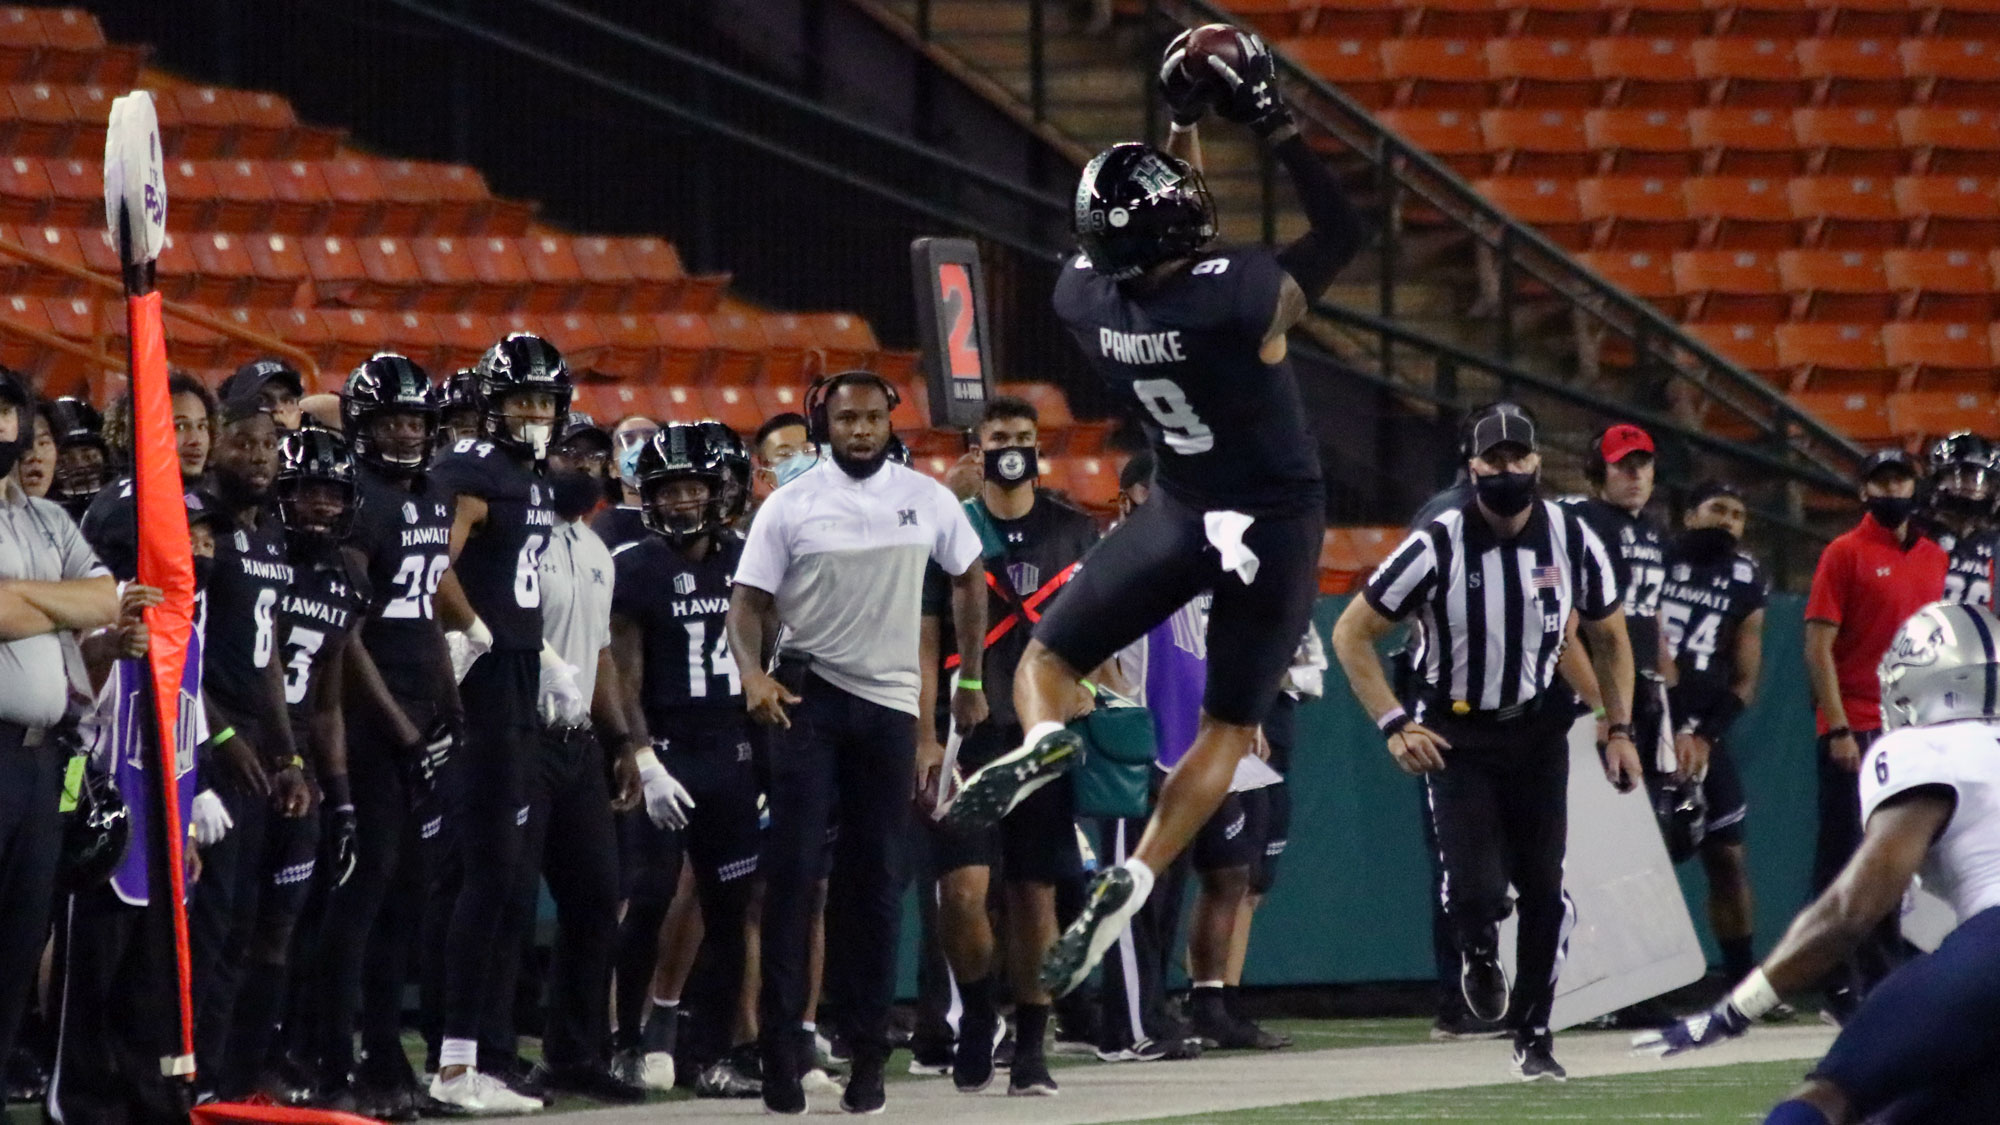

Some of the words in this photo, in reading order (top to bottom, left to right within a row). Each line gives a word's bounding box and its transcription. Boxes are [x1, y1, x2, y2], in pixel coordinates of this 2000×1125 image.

[1191, 257, 1230, 276] 9
[939, 263, 982, 379] 2
[1099, 327, 1187, 365] PANOKE
[1132, 378, 1215, 456] 9
[453, 438, 496, 459] 84
[401, 527, 450, 547] HAWAII
[1469, 571, 1481, 589] S
[1662, 582, 1731, 611] HAWAII
[253, 588, 276, 668] 8
[1544, 612, 1559, 634] H
[1660, 600, 1722, 672] 54
[282, 626, 326, 704] 3
[683, 621, 742, 697] 14
[1873, 750, 1891, 785] 6
